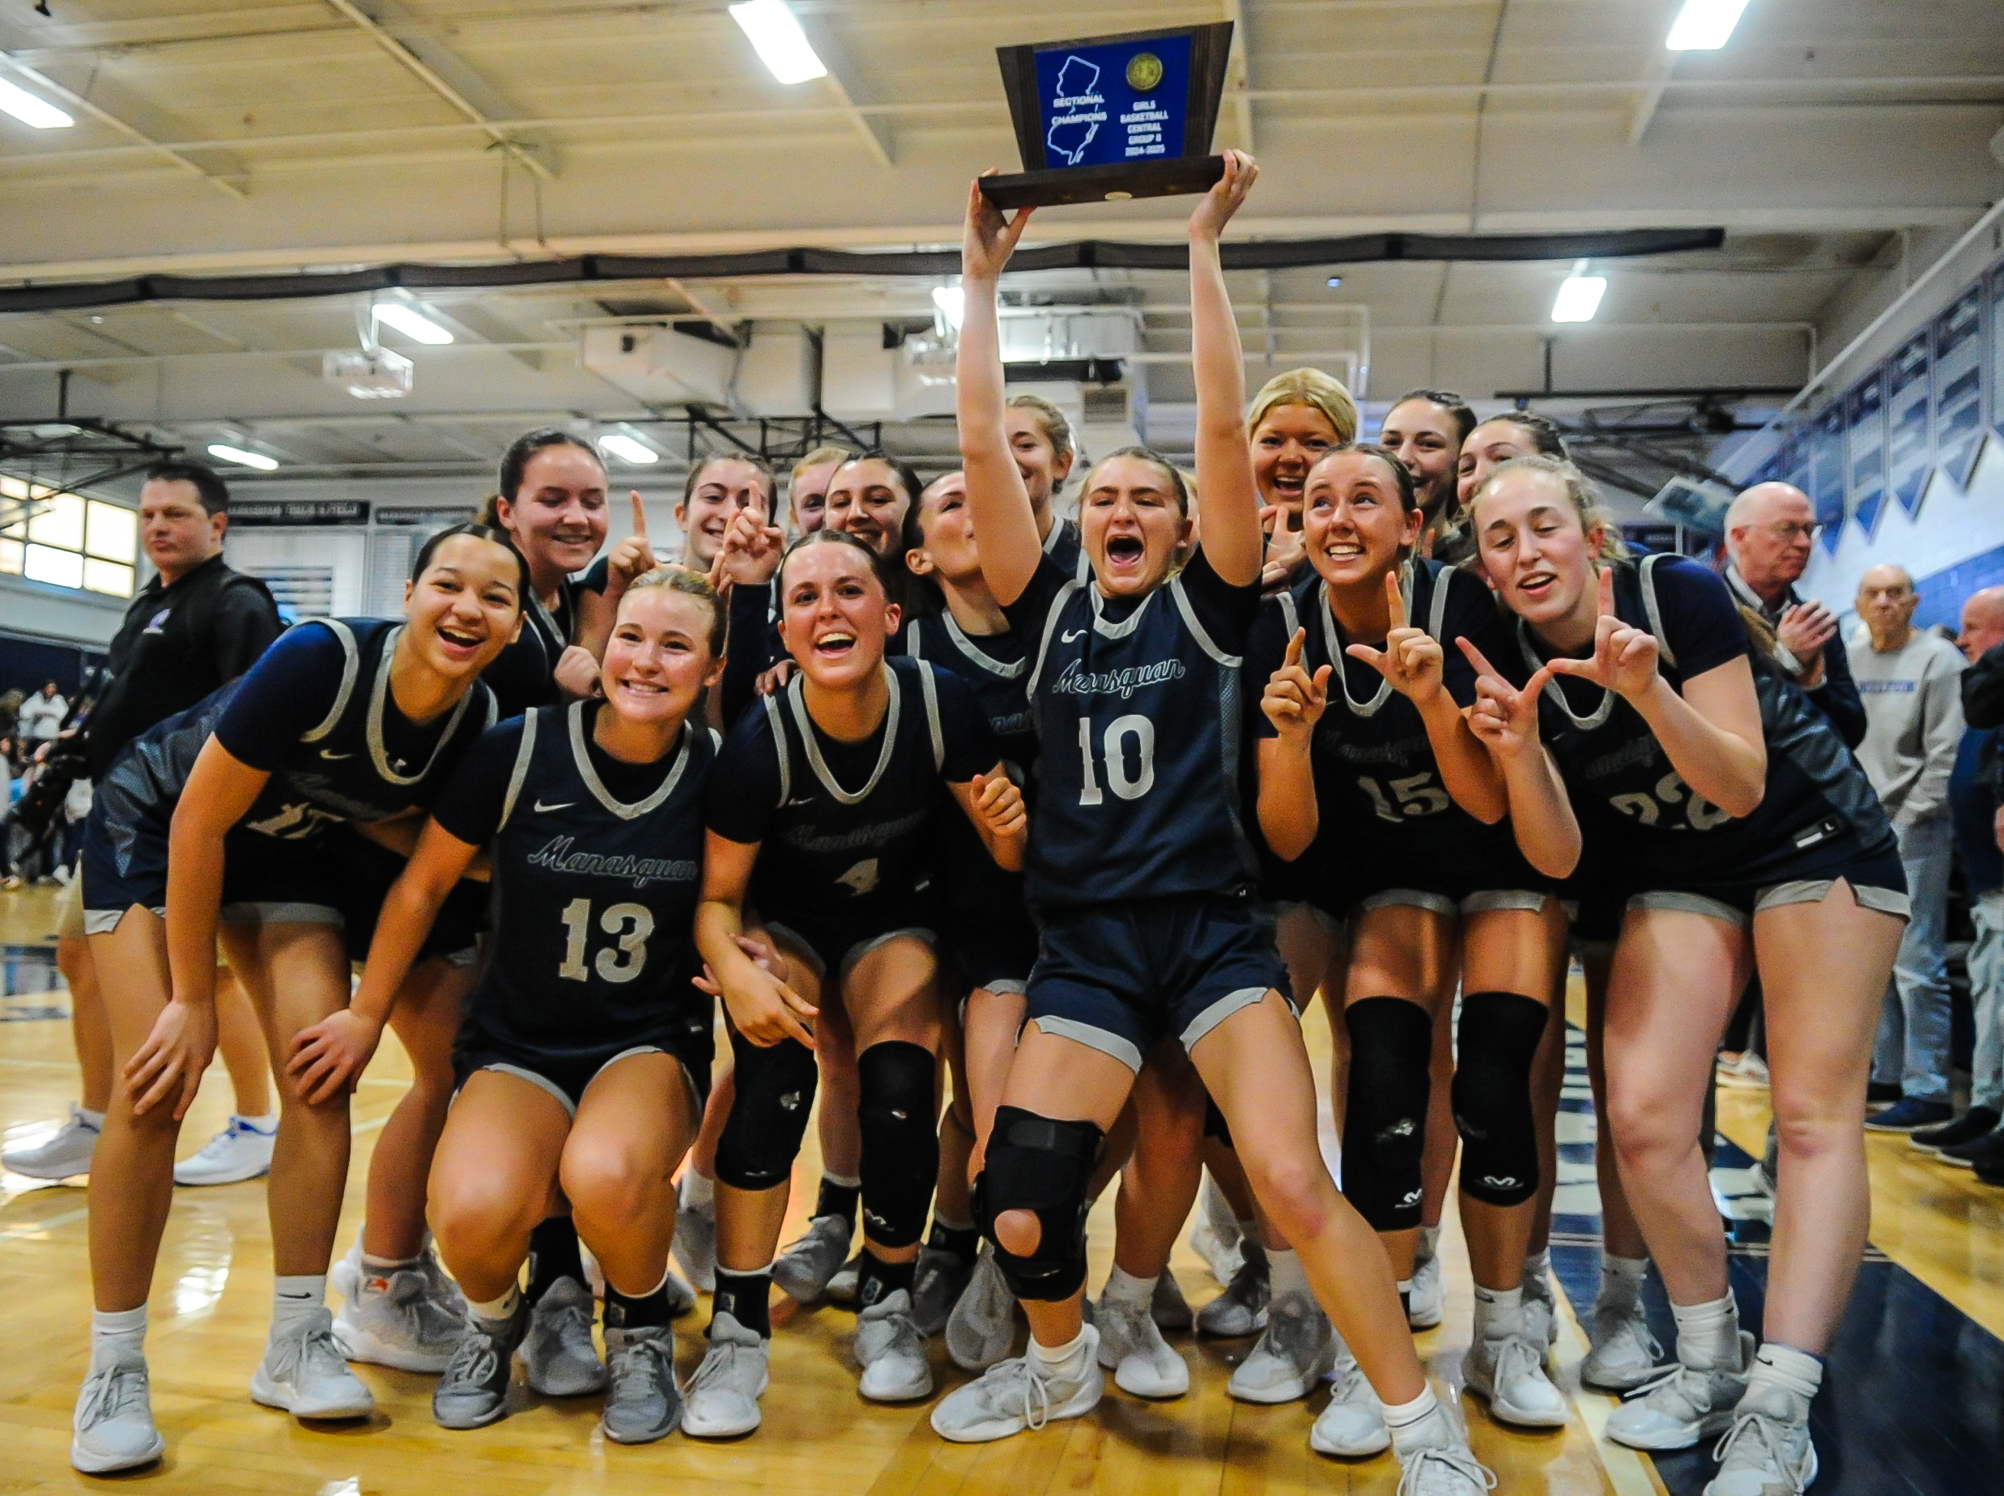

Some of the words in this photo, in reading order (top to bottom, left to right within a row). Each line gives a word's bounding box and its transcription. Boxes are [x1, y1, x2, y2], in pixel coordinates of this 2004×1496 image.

[1053, 94, 1105, 108] SECTIONAL
[1133, 100, 1156, 111] GIRLS
[1052, 111, 1107, 125] CHAMPIONS
[1120, 110, 1169, 124] BASKETBALL
[1127, 122, 1162, 134] CENTRAL
[1078, 714, 1155, 805] 10
[1357, 771, 1449, 822] 15
[527, 834, 699, 888] Manasquan
[559, 898, 655, 983] 13
